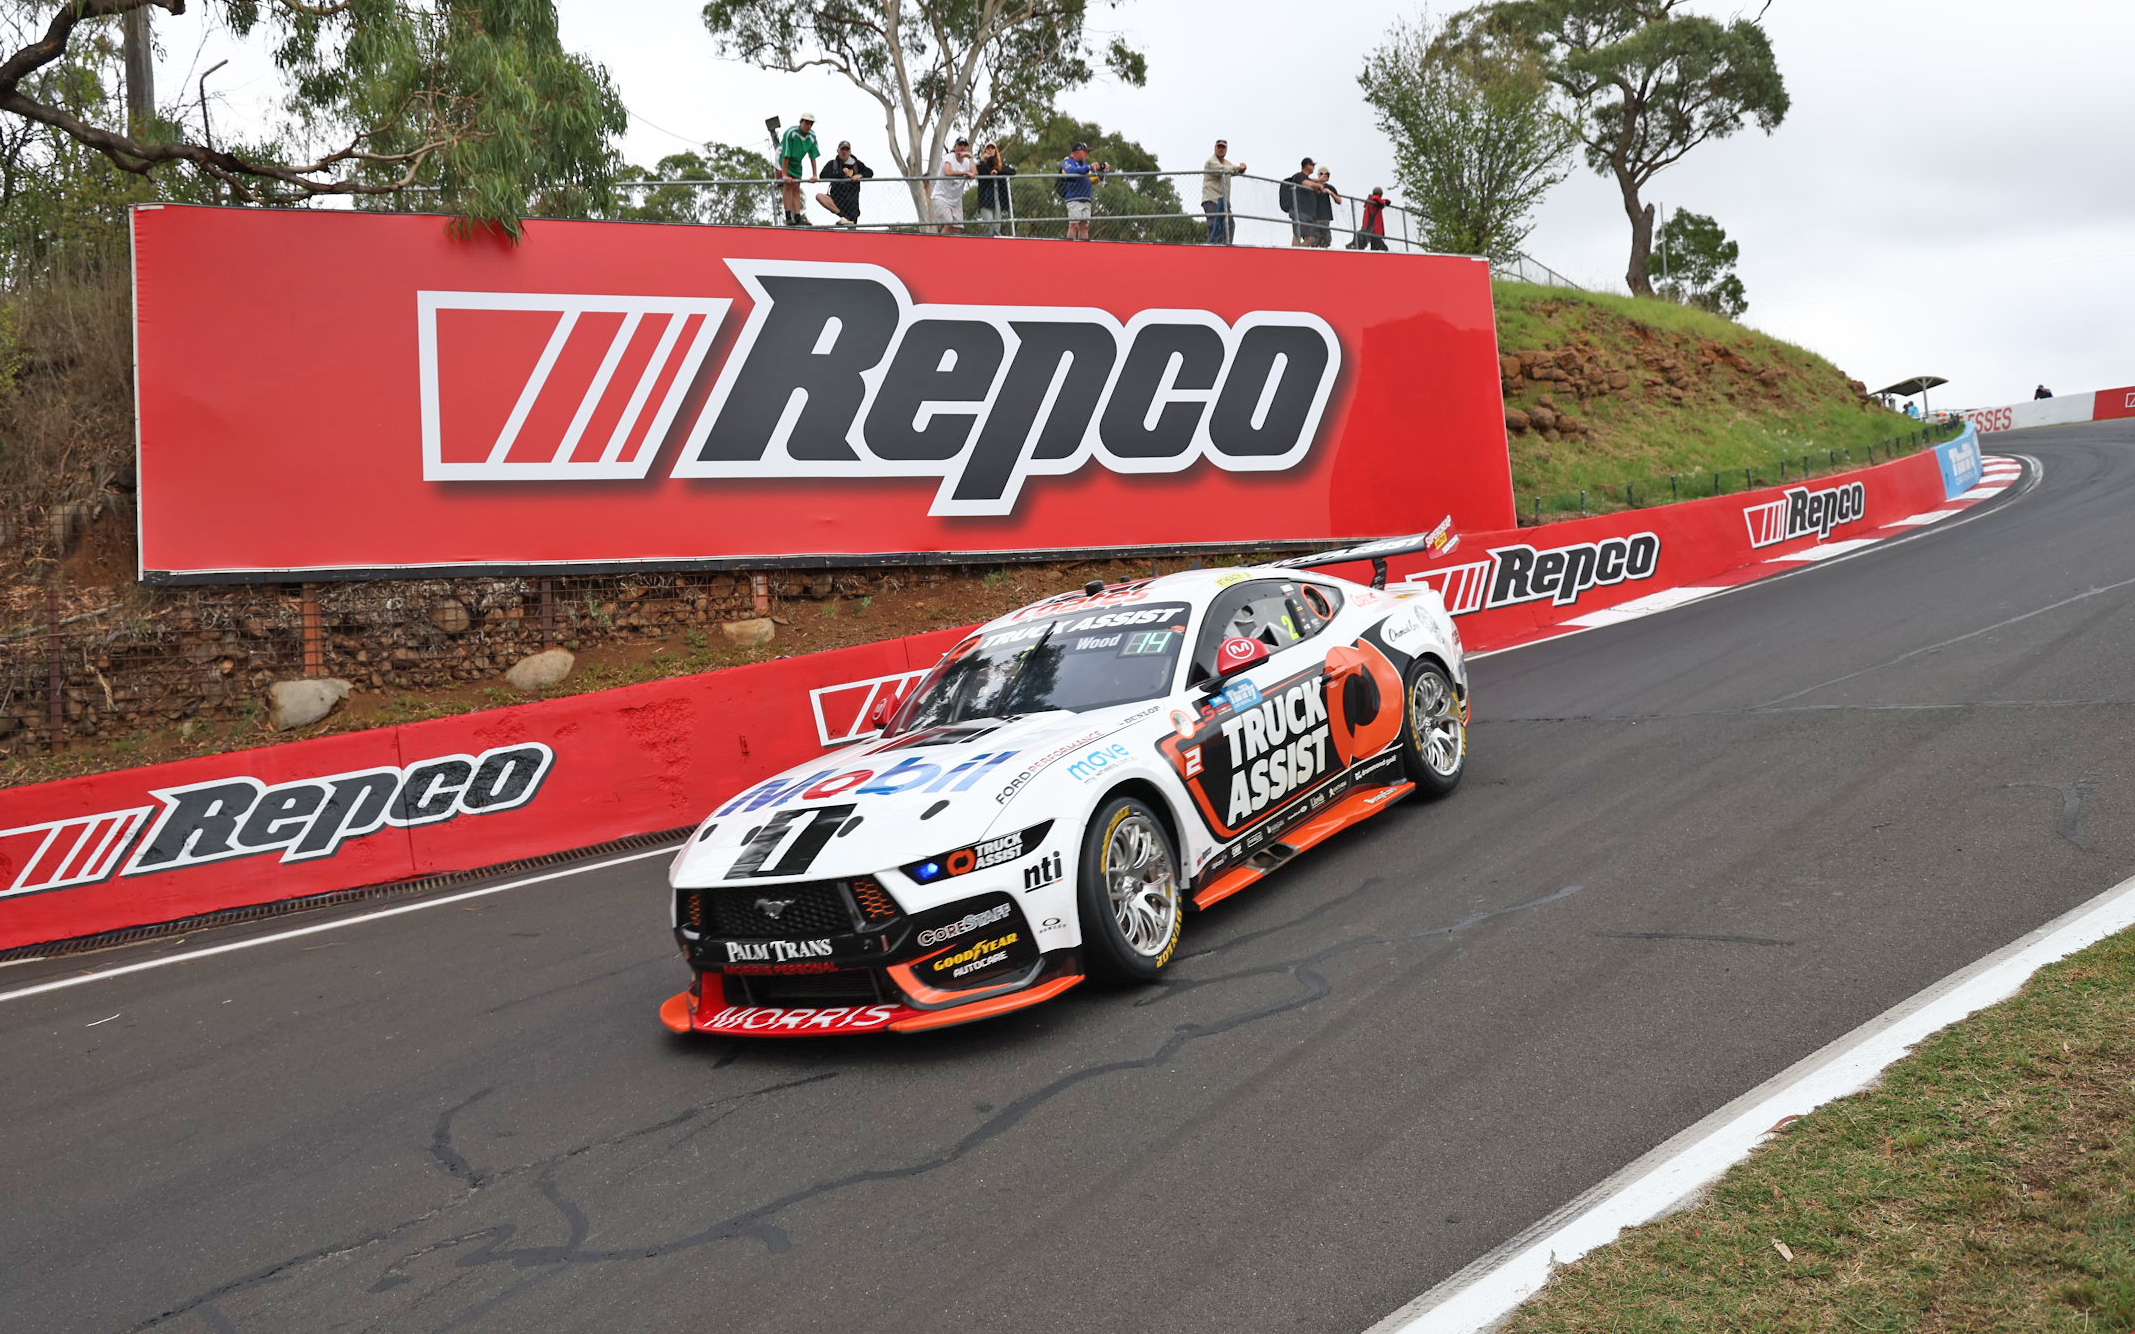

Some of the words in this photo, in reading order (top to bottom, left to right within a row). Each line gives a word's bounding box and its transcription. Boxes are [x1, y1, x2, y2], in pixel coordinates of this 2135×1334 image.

[676, 262, 1339, 513] Repco
[1784, 482, 1865, 539] Repco
[1487, 533, 1660, 606] Repco
[982, 620, 1069, 649] TRUCK
[1068, 608, 1185, 633] ASSIST
[1076, 634, 1122, 650] Wood
[1124, 705, 1160, 724] DUNLOP
[1221, 676, 1328, 769] TRUCK
[995, 771, 1031, 804] FORD
[1028, 730, 1103, 772] PERFORMANCE
[1067, 743, 1131, 781] move
[1184, 747, 1203, 777] 2
[1227, 724, 1329, 827] ASSIST
[122, 742, 555, 862] Repco
[715, 750, 1021, 817] Mobil
[974, 844, 1022, 869] ASSIST
[975, 831, 1022, 857] TRUCK
[1024, 851, 1062, 888] nti
[725, 941, 770, 962] PALM
[769, 938, 833, 962] TRANS
[933, 932, 1019, 971] GOODYEAR
[953, 951, 1008, 978] AUTOCARE
[703, 1004, 901, 1030] MORRIS
